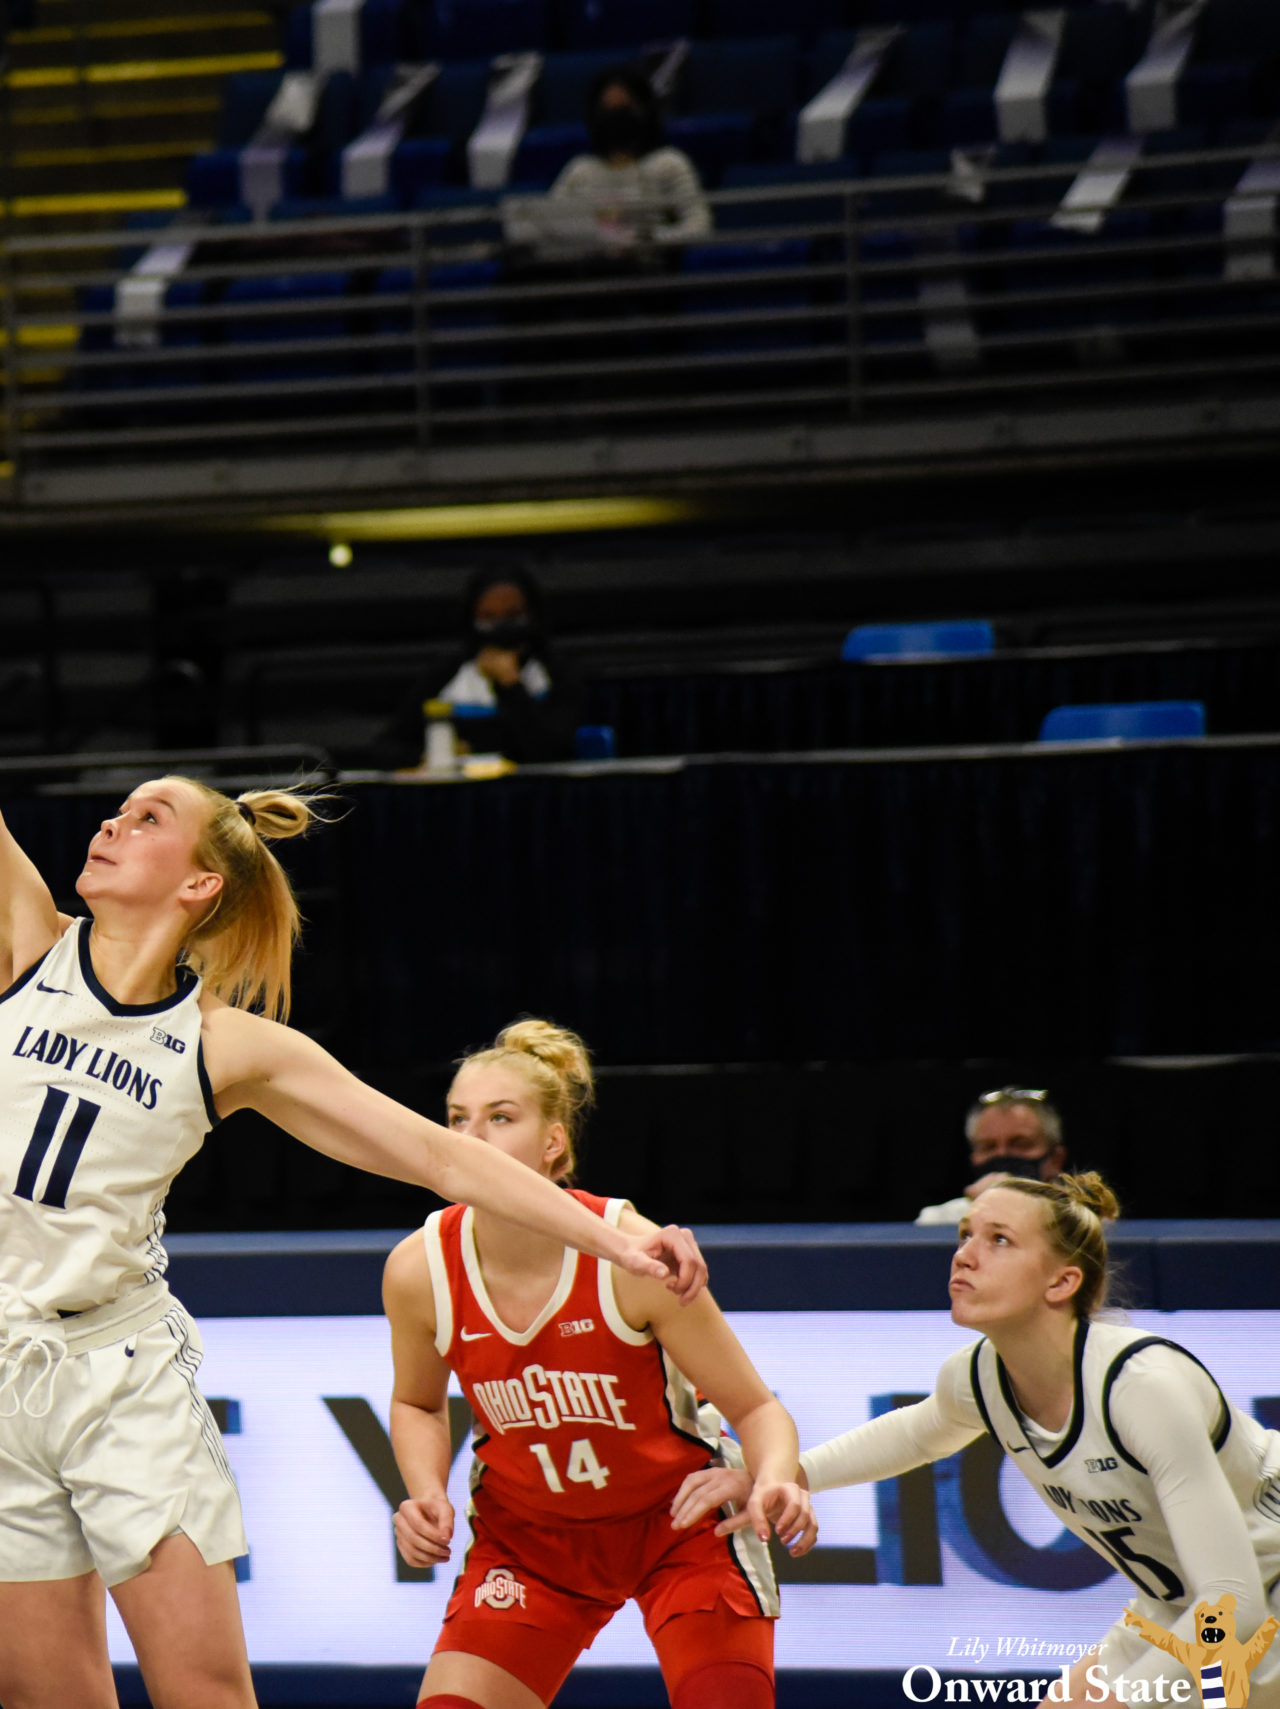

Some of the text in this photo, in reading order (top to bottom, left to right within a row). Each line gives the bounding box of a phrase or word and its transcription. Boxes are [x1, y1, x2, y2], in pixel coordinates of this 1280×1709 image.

[12, 1026, 163, 1110] LADY LIONS
[12, 1085, 102, 1210] 11
[522, 1364, 637, 1430] STATE
[529, 1438, 611, 1493] 14
